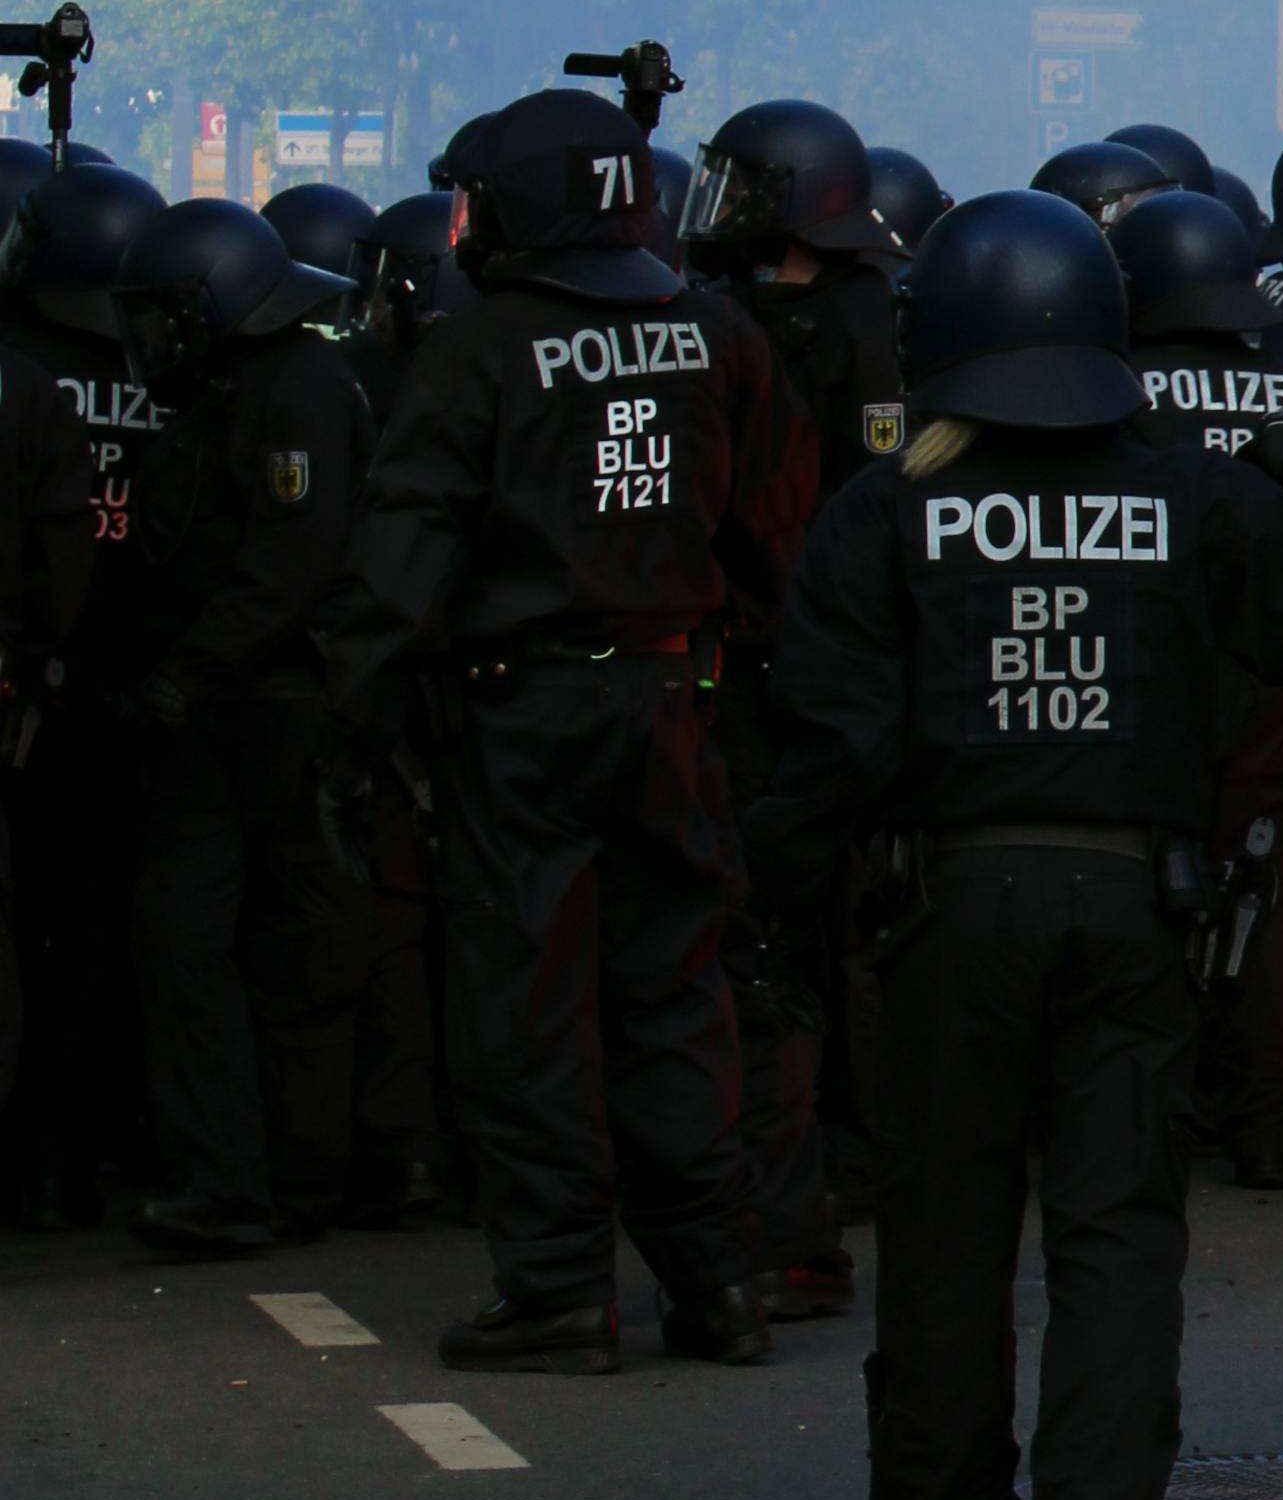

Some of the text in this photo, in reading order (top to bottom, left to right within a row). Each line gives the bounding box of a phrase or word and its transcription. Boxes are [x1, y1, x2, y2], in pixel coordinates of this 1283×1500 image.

[592, 155, 634, 210] 71
[533, 322, 709, 389] POLIZEI
[608, 398, 657, 436] BP
[598, 435, 671, 474] BLU
[593, 472, 670, 512] 7121
[926, 493, 1168, 562] POLIZEI
[1011, 586, 1089, 631] BP
[991, 636, 1106, 681] BLU
[987, 686, 1110, 731] 1102
